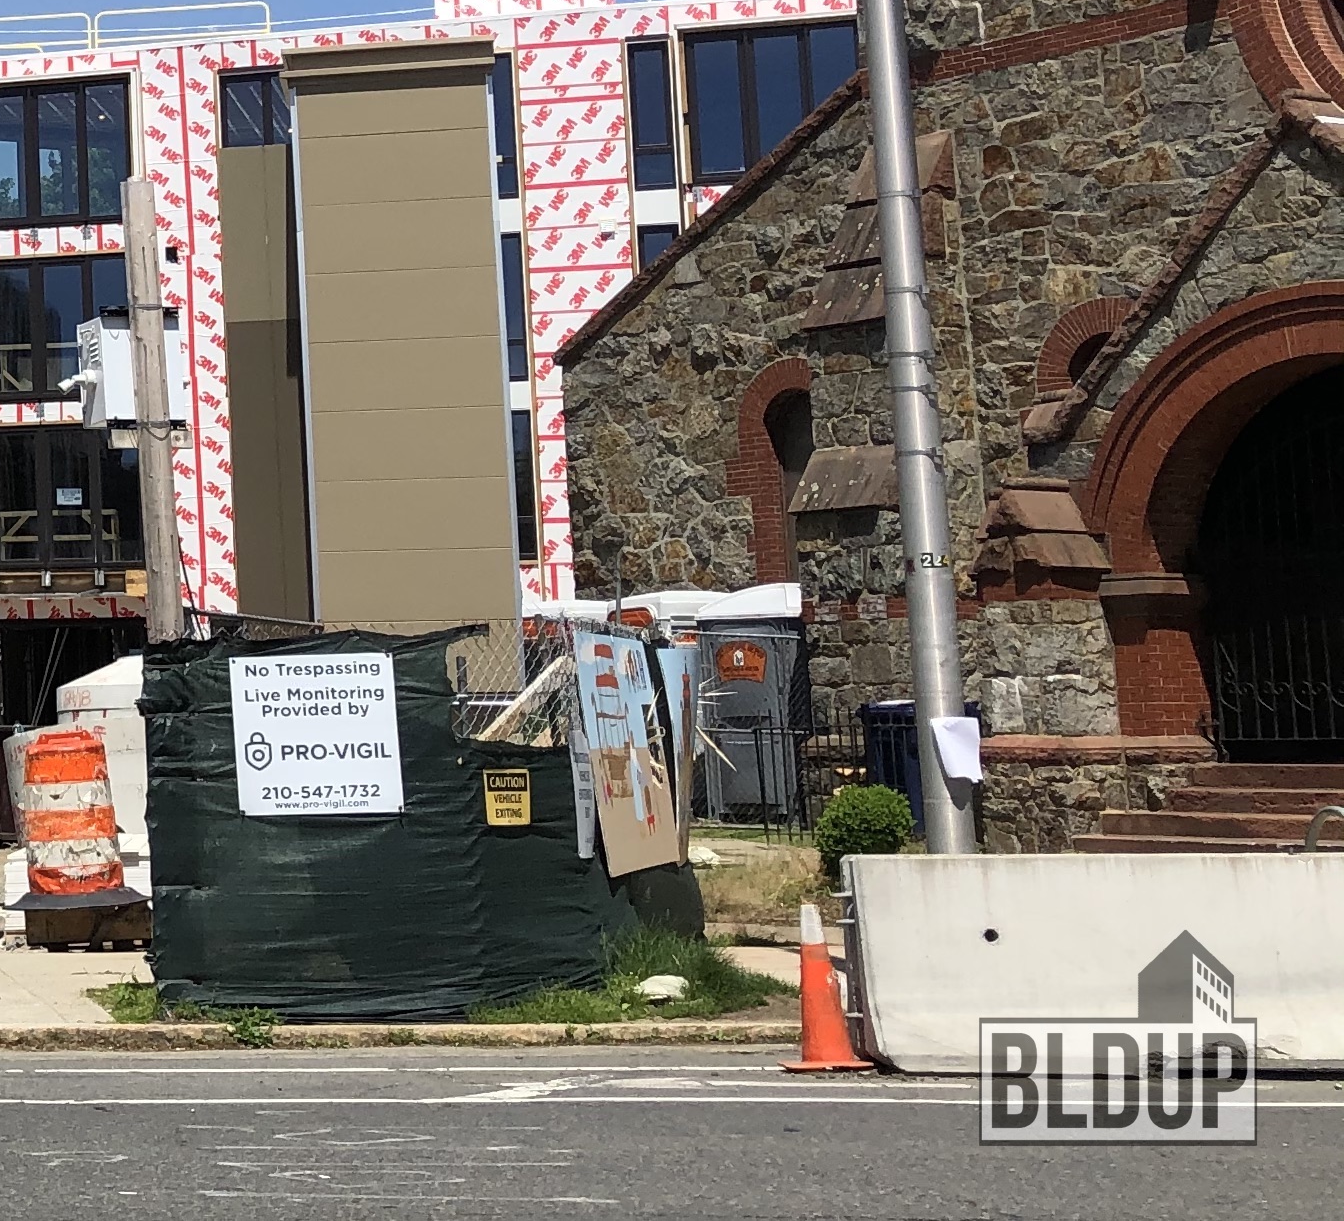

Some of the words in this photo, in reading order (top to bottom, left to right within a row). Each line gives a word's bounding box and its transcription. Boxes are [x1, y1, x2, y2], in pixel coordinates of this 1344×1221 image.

[245, 664, 269, 677] No
[275, 661, 380, 677] Trespassing
[244, 689, 280, 702] Live
[287, 686, 384, 701] Monitoring
[262, 703, 341, 717] Provided
[348, 702, 369, 717] by
[281, 742, 392, 760] PRO-VIGIL
[490, 777, 525, 788] CAUTION
[262, 784, 380, 800] 210-547-1732
[494, 794, 522, 803] VEHICLE
[275, 800, 369, 809] www.pro-vigil.com
[496, 808, 522, 818] EXITING
